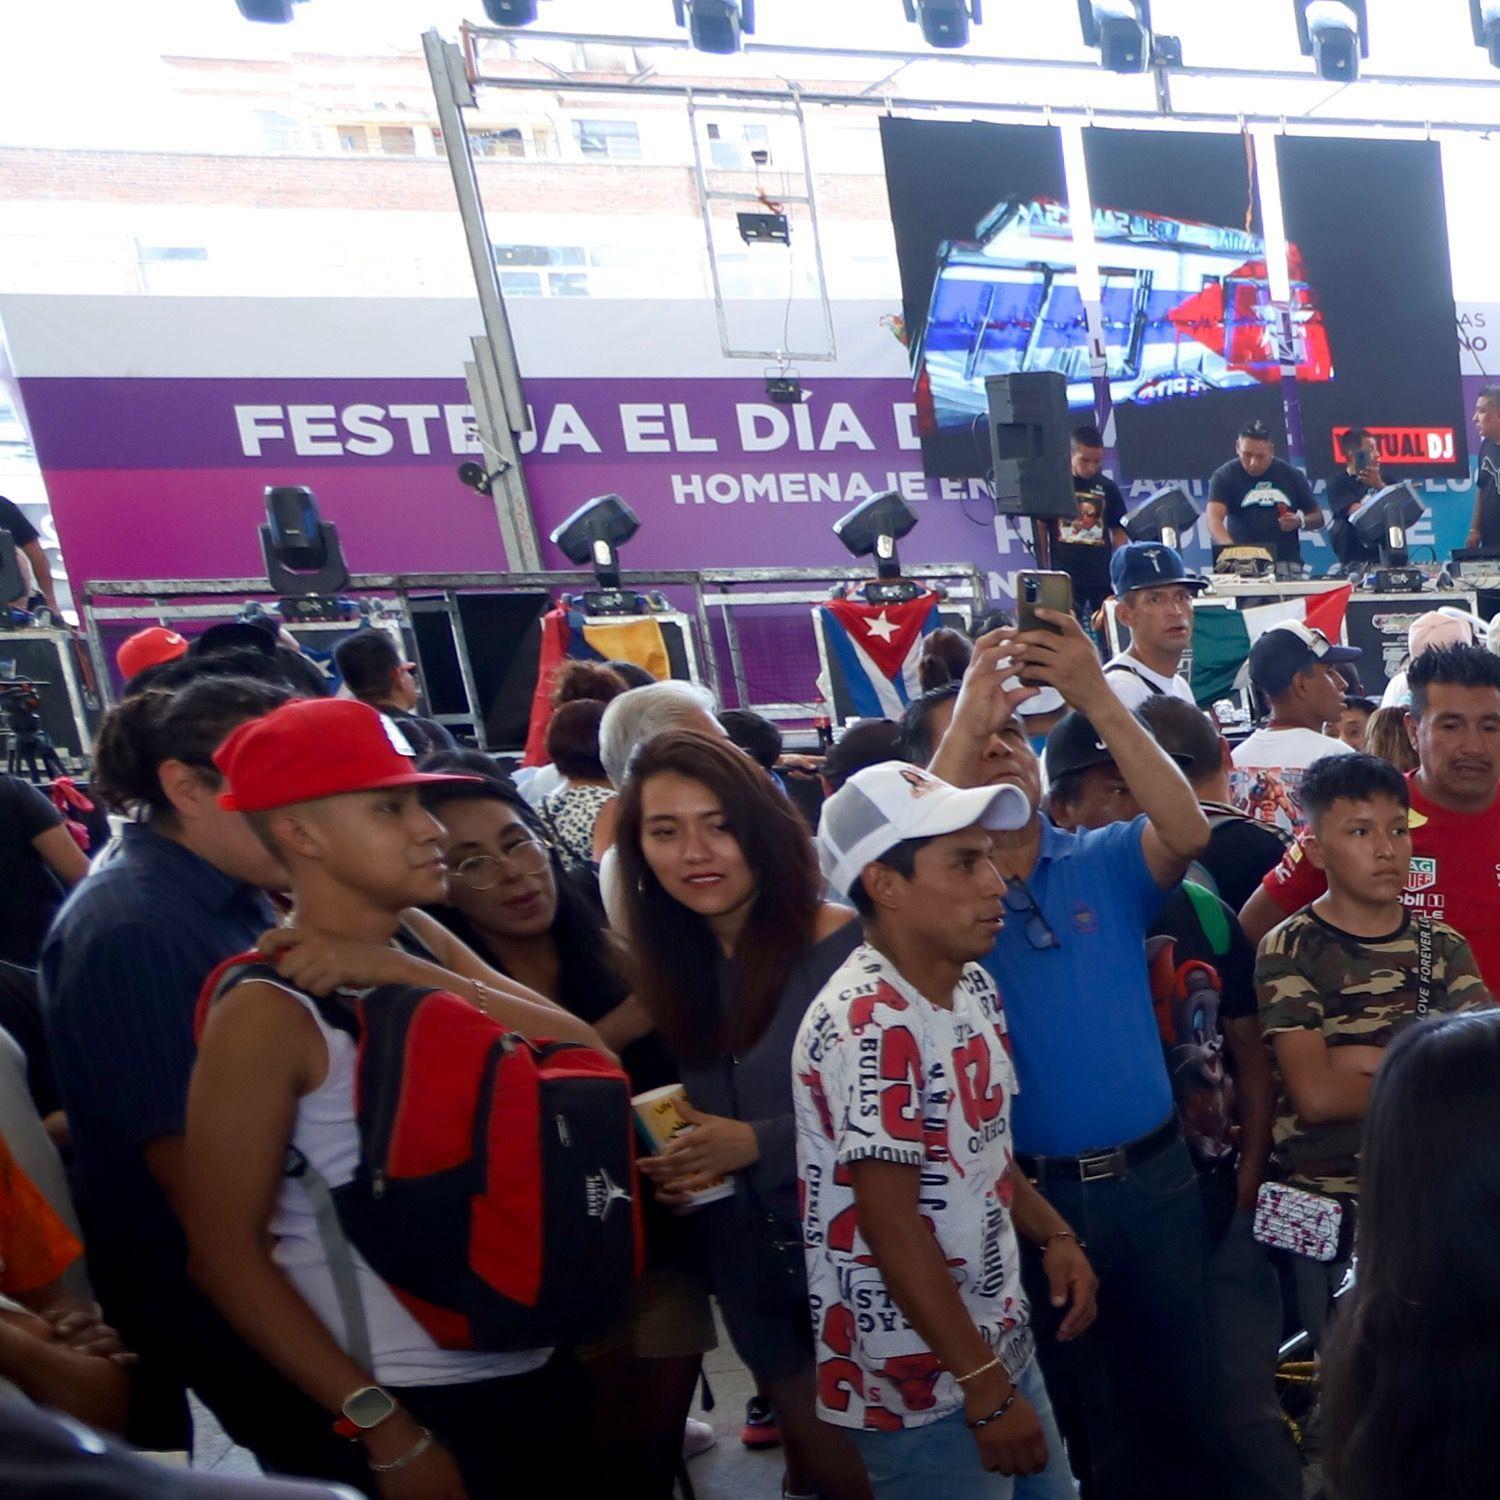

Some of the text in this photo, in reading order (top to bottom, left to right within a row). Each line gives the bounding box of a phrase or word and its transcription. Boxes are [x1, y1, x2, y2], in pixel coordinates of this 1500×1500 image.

[619, 403, 718, 453] EL
[736, 388, 876, 452] DÍA
[1427, 432, 1455, 458] DJ
[1409, 861, 1433, 873] AG
[1397, 893, 1424, 907] obil
[1420, 931, 1433, 984] FOREVER
[1418, 987, 1430, 1022] LOVE
[858, 1037, 880, 1118] BULLS
